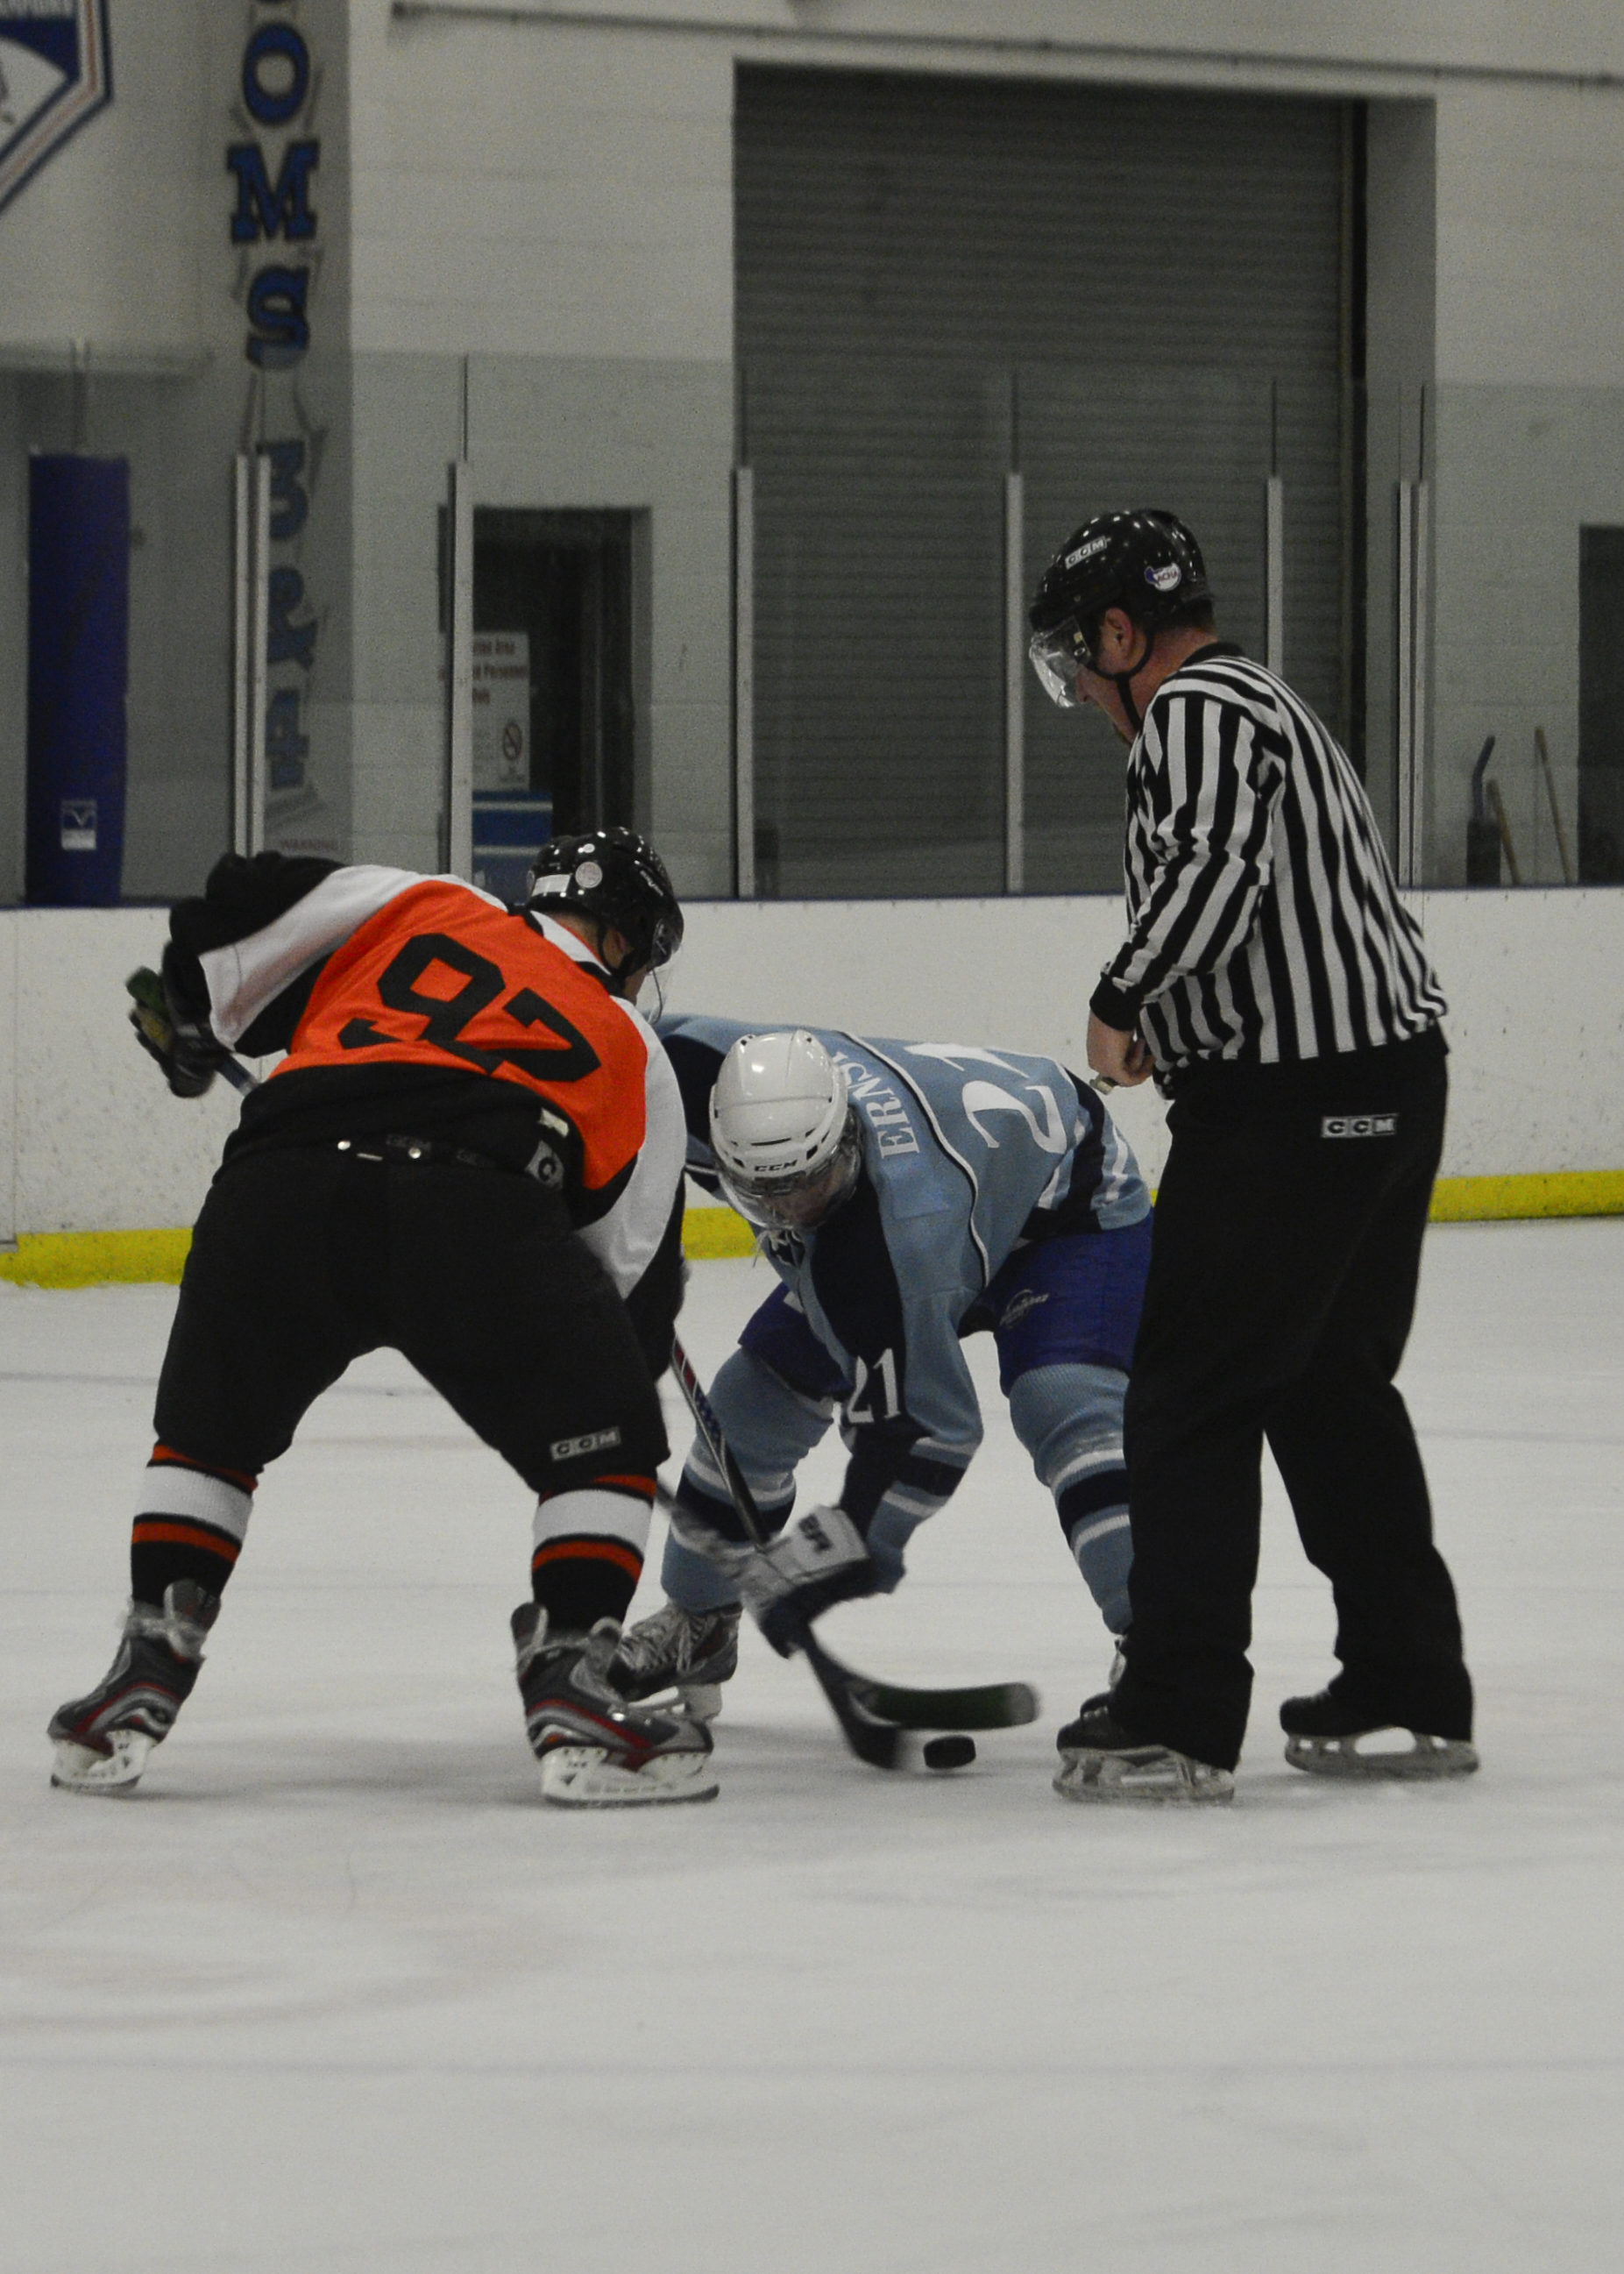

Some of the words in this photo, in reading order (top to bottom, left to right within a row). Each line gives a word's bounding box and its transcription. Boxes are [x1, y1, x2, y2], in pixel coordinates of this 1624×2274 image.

[226, 0, 322, 371] OMS
[1067, 537, 1106, 567] CCM
[337, 933, 602, 1084] 97
[1324, 1114, 1398, 1137] CCM
[755, 1159, 798, 1172] CCM
[847, 1347, 901, 1425] 21
[553, 1428, 621, 1458] CCM
